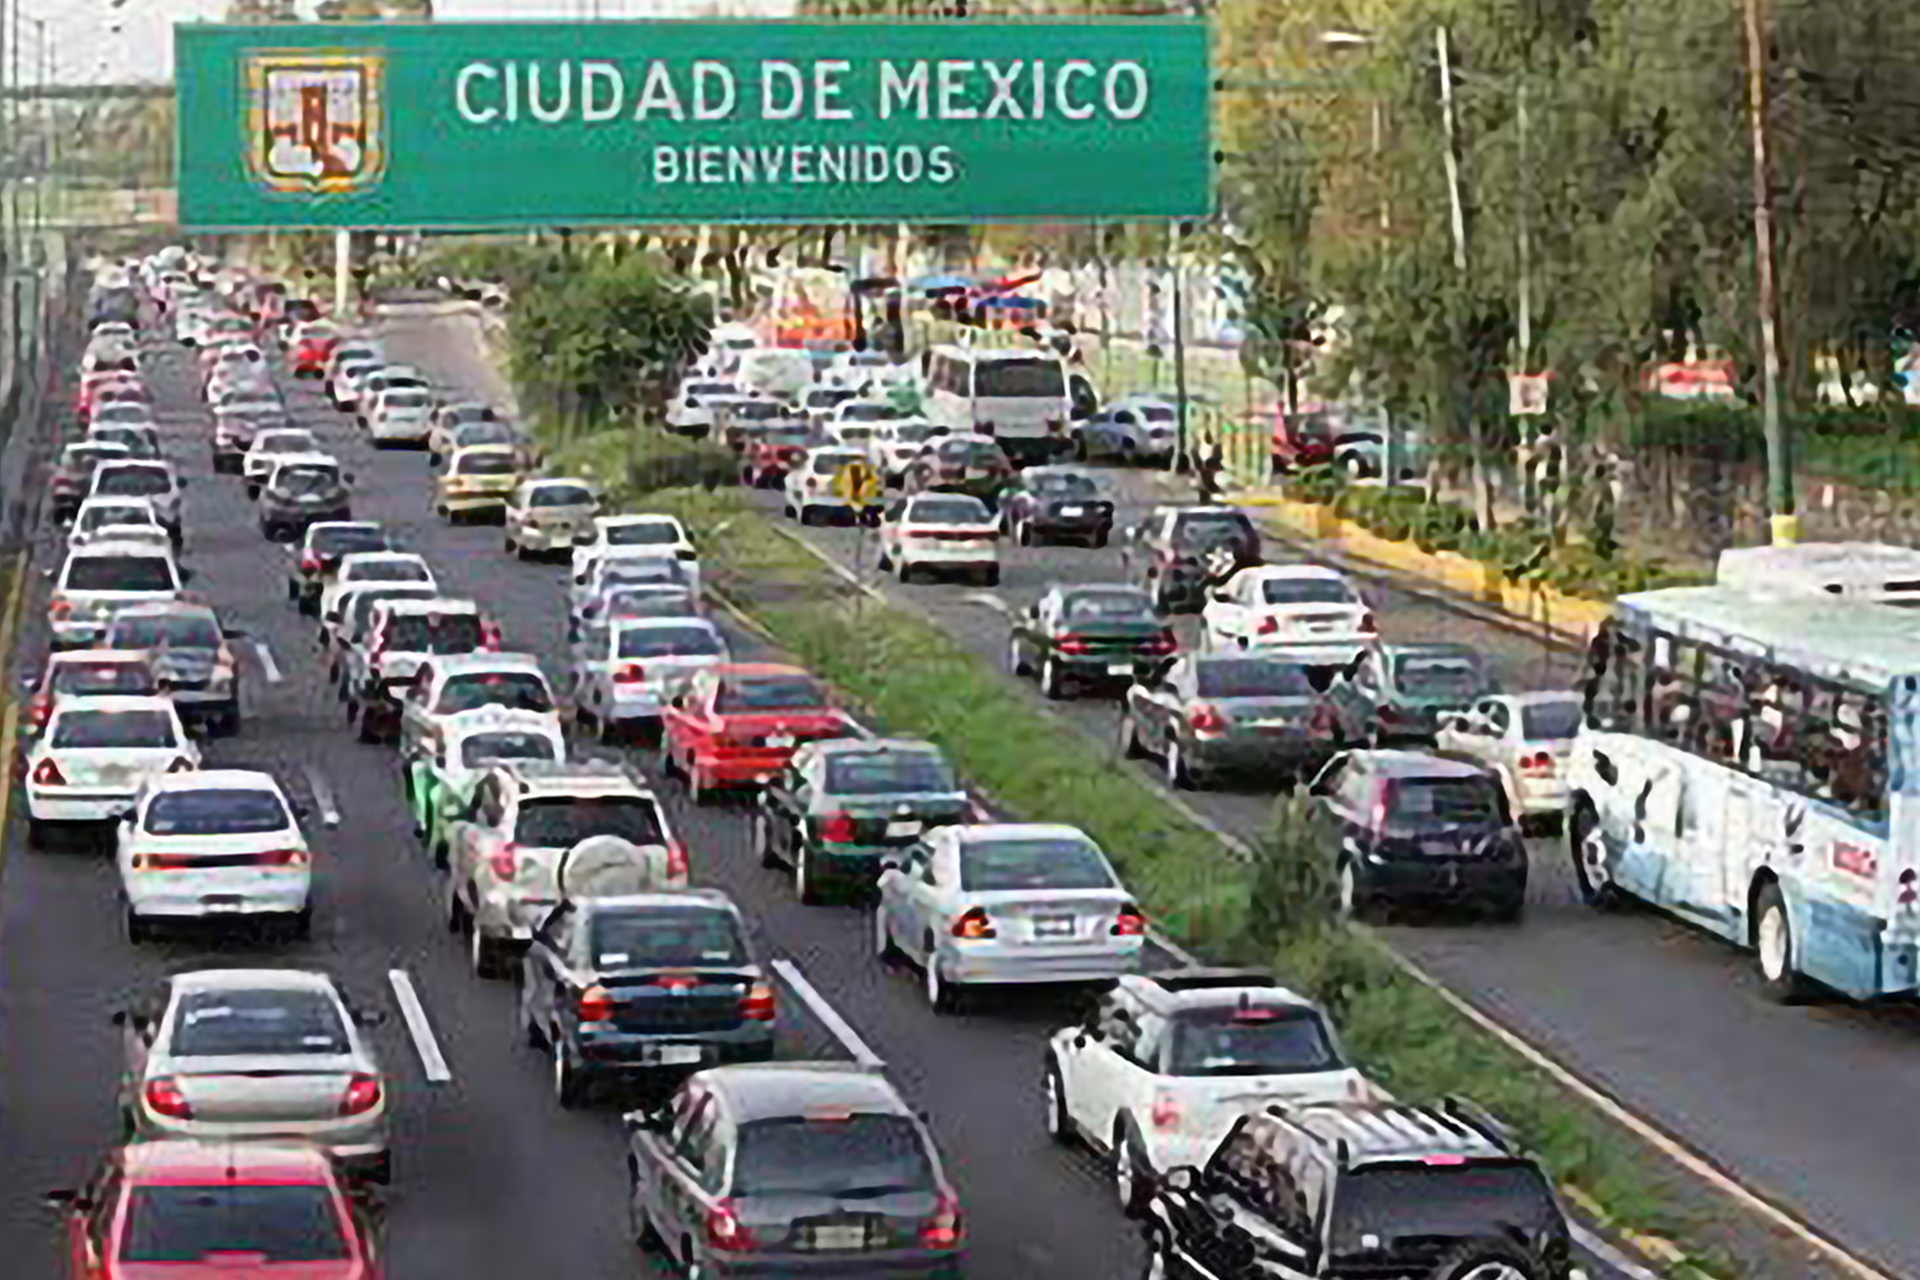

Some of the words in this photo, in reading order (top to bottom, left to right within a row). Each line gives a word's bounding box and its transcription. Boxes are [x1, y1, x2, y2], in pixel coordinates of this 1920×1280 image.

[454, 60, 735, 123] CIUDAD
[760, 60, 854, 120] DE
[879, 59, 1149, 120] MEXICO
[653, 145, 954, 184] BIENVENIDOS
